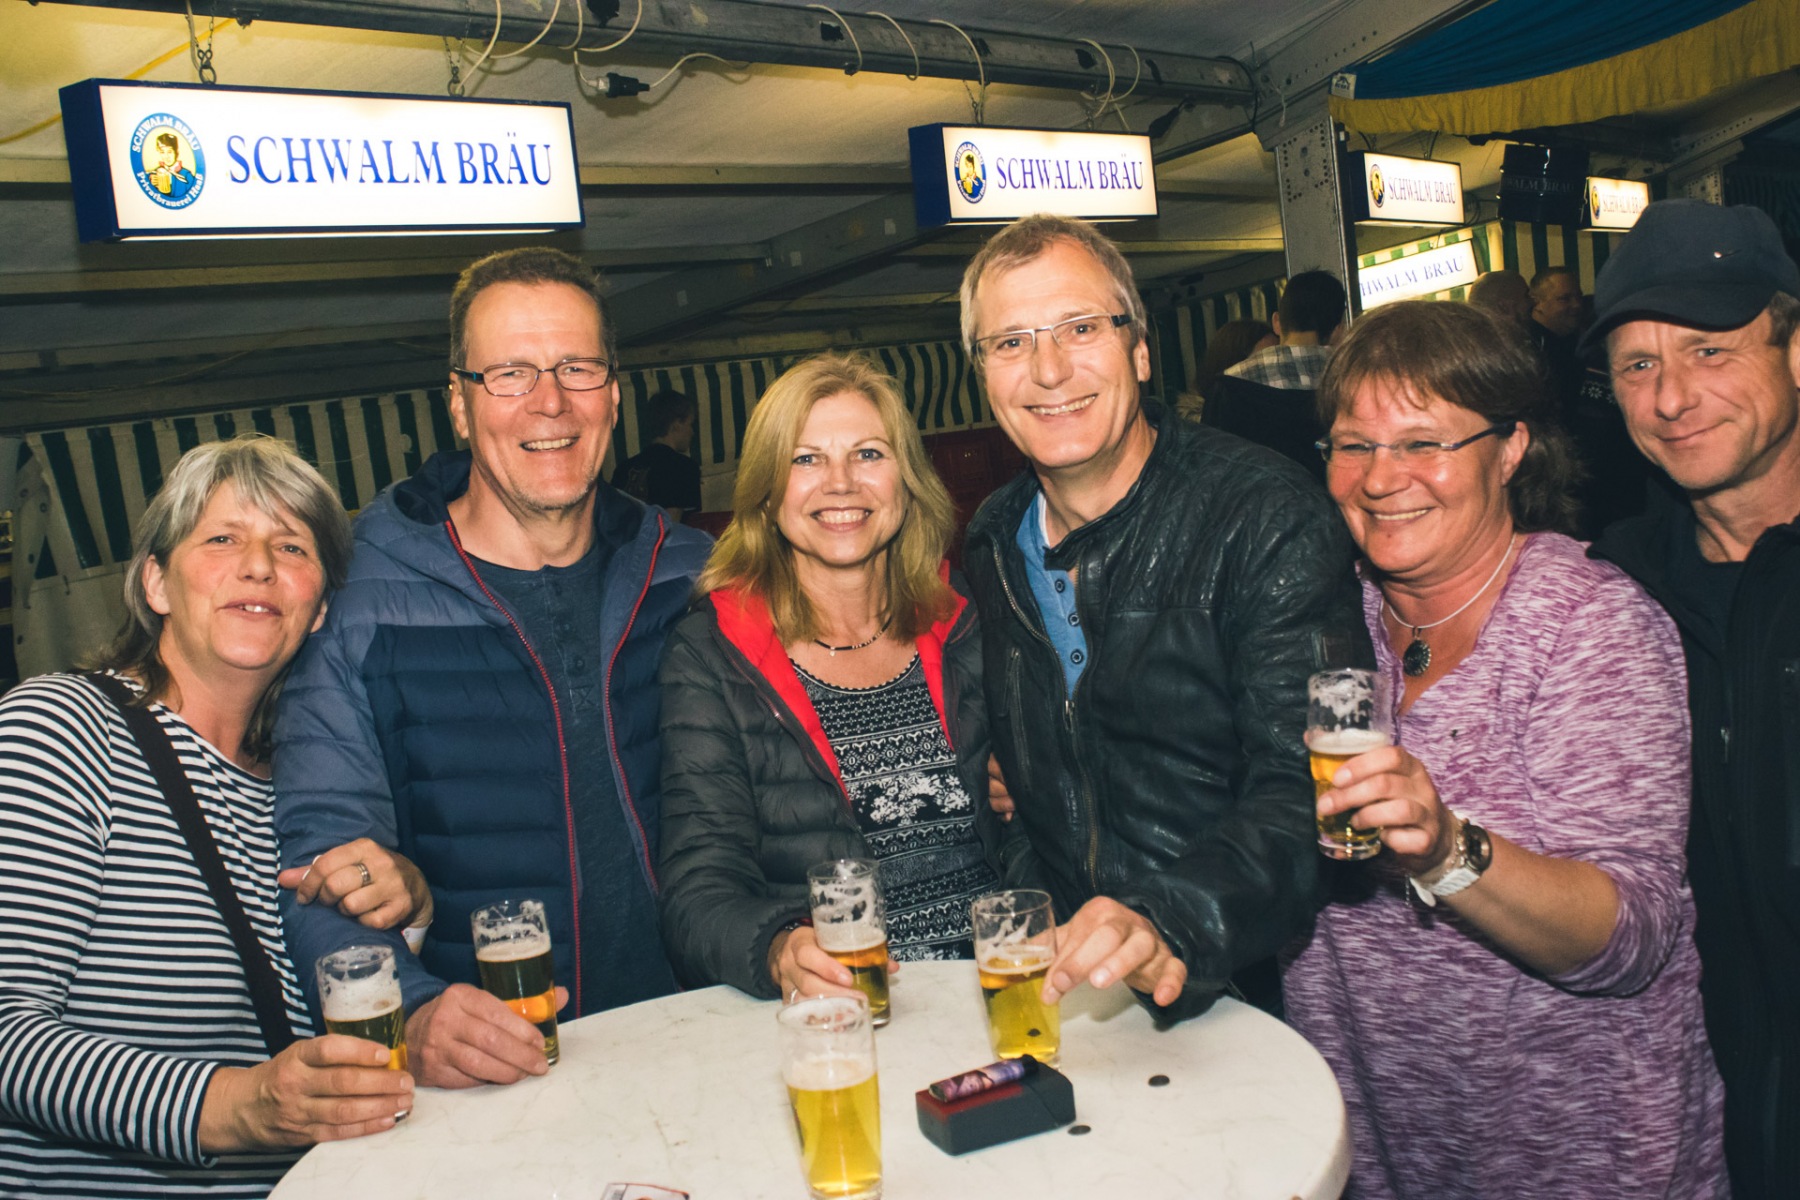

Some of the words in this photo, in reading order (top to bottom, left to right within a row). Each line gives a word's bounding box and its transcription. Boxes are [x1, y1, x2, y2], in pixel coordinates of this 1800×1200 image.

[132, 115, 174, 153] SCHWALM
[226, 134, 446, 184] SCHWALM
[454, 132, 552, 186] BRÄU
[996, 157, 1095, 189] SCHWALM
[1097, 153, 1144, 189] BRÄU
[1388, 176, 1433, 203] SCHWALM
[1359, 269, 1418, 297] HWALM
